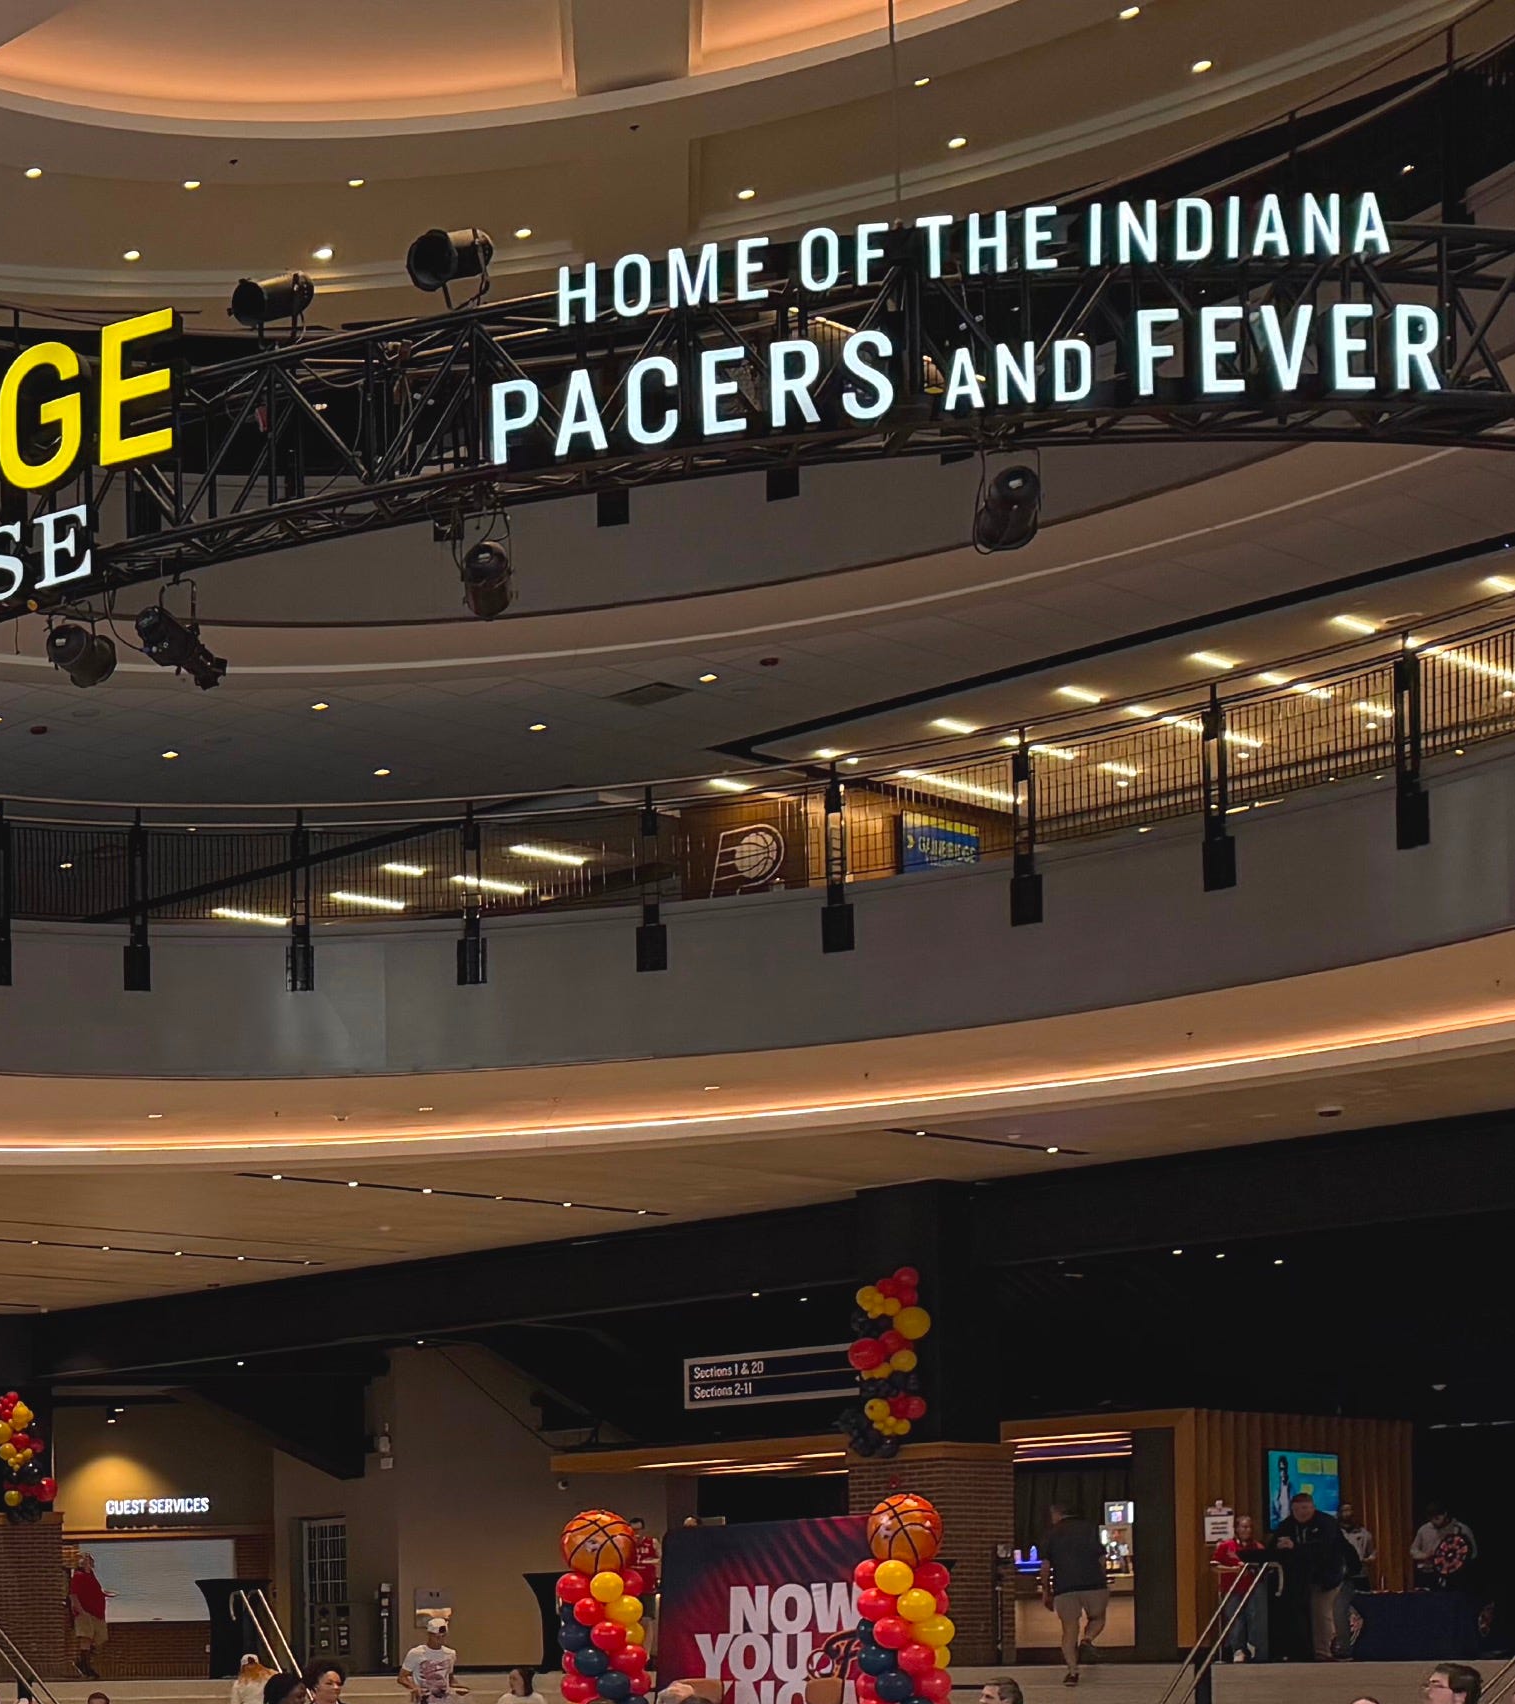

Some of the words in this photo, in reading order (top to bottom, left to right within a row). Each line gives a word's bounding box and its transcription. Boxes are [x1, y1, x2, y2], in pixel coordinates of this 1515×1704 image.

[558, 235, 769, 328] HOME
[799, 220, 890, 295] OF
[915, 204, 1060, 280] THE
[1087, 191, 1391, 267] INDIANA
[489, 329, 894, 465] PACERS
[944, 337, 1093, 411] AND
[1135, 302, 1443, 395] FEVER
[693, 1364, 733, 1380] Sections
[740, 1363, 750, 1375] &
[750, 1360, 765, 1375] 20
[694, 1385, 733, 1400] Sections
[105, 1498, 146, 1516] GUEST
[148, 1496, 211, 1515] SERVICES
[729, 1582, 865, 1635] NOW
[694, 1631, 813, 1684] YOU
